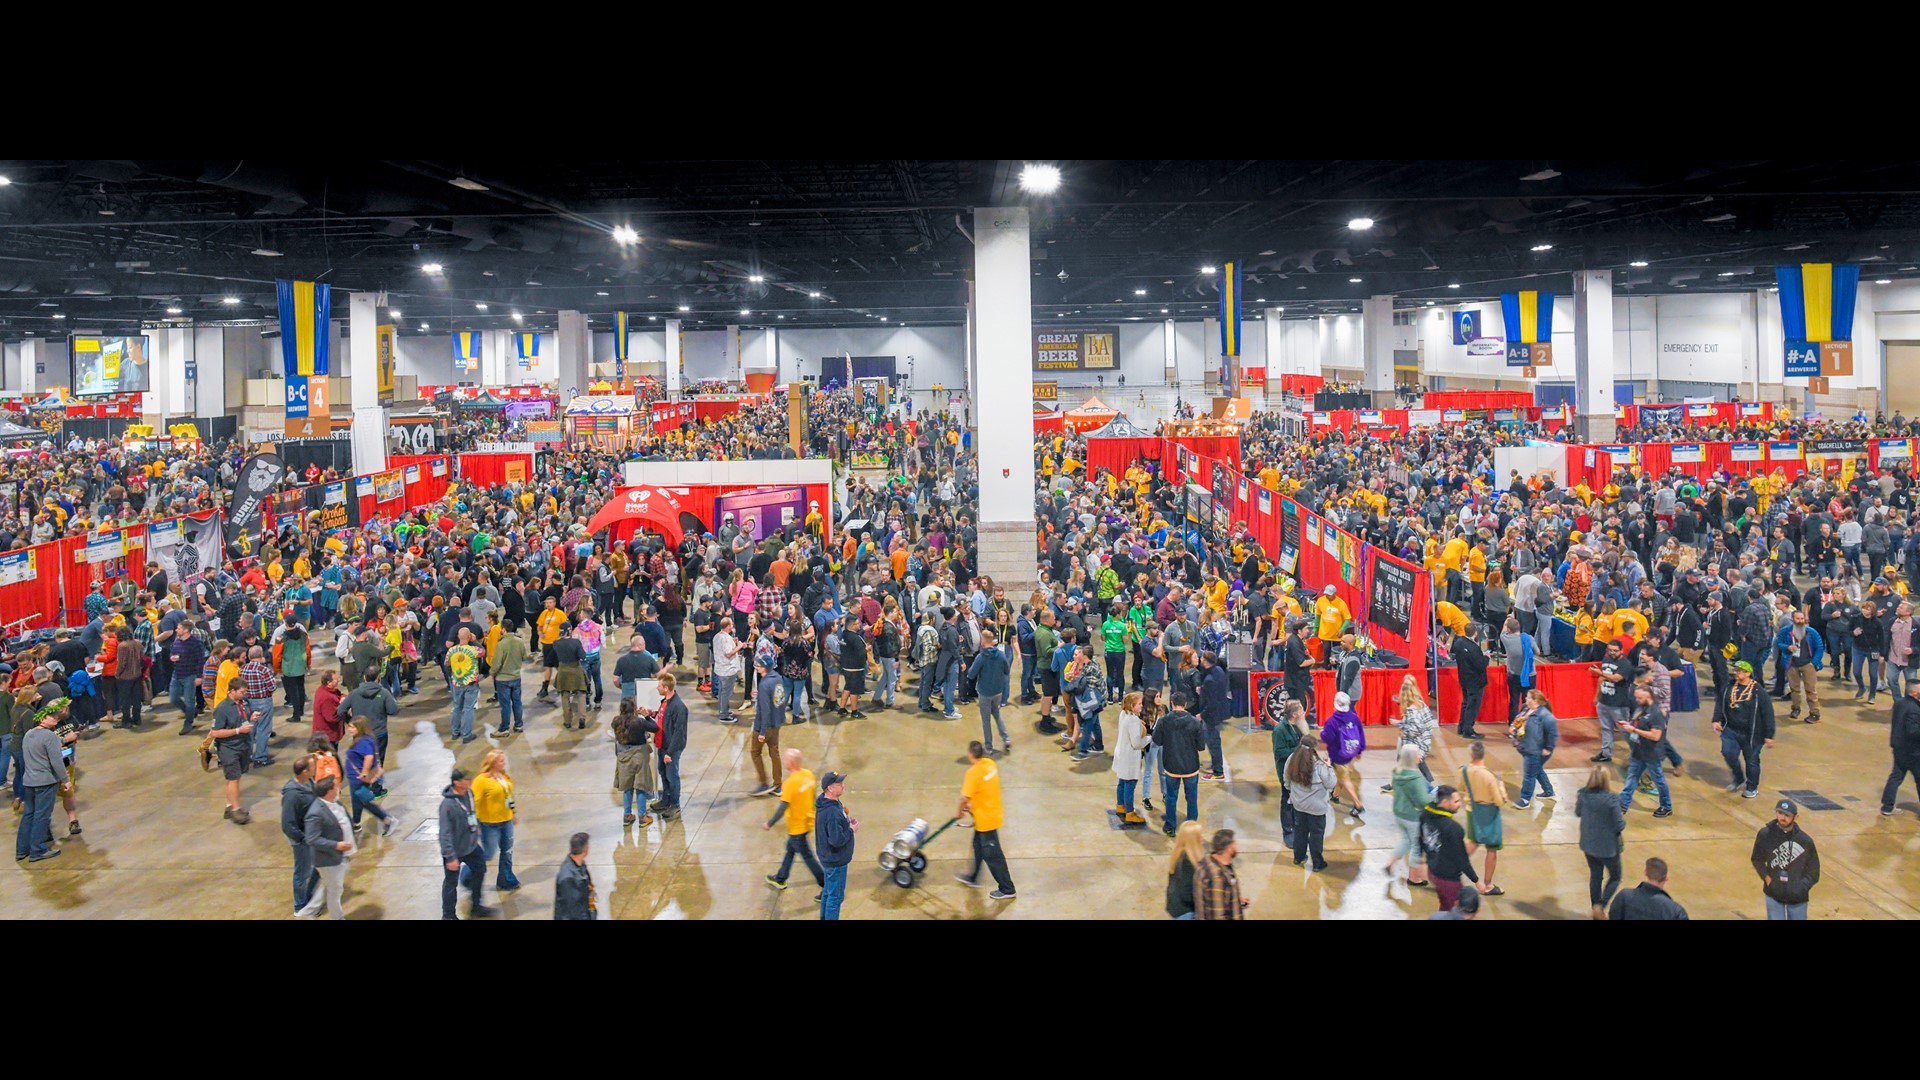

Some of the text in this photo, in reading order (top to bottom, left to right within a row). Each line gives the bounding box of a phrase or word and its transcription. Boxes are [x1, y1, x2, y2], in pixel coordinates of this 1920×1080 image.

[1038, 334, 1078, 343] GREAT
[1509, 348, 1528, 357] A-B
[1664, 344, 1718, 352] EMERGENCY EXIT
[1038, 350, 1078, 362] BEER
[1537, 350, 1546, 362] 2
[1787, 349, 1817, 364] #-A
[1832, 352, 1840, 370] 1
[288, 384, 306, 402] B-C
[1817, 382, 1820, 392] 1
[314, 388, 323, 408] 4
[1228, 404, 1236, 416] 3
[302, 423, 313, 435] 4
[232, 494, 255, 524] BURLY
[1400, 570, 1410, 581] BEER
[1780, 855, 1795, 869] FACE
